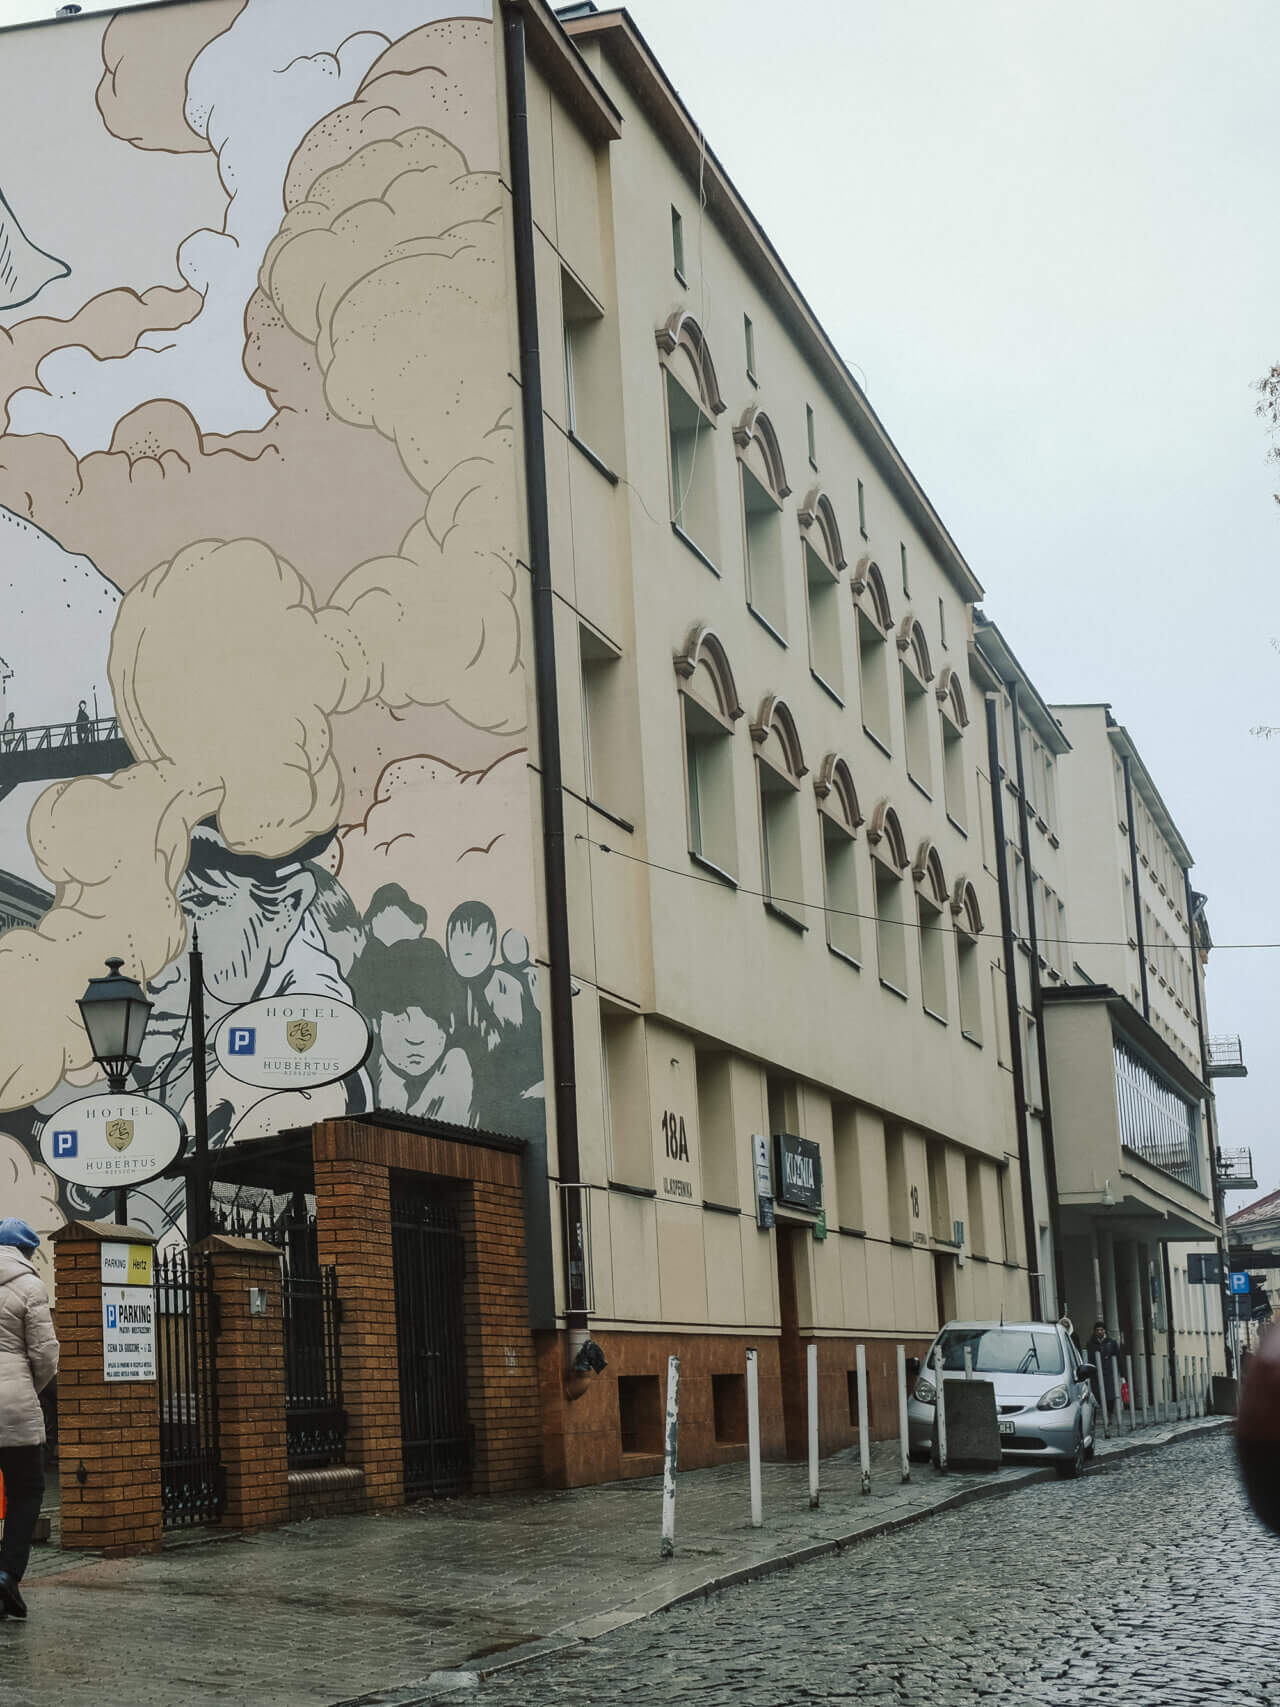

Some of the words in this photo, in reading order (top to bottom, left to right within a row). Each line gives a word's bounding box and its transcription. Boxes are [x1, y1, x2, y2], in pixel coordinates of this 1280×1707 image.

[266, 1007, 340, 1018] HOTEL
[234, 1031, 250, 1051] P
[263, 1060, 340, 1071] HUBERTUS
[86, 1106, 153, 1119] HOTEL
[661, 1109, 690, 1163] 18A
[58, 1134, 72, 1154] P
[86, 1158, 157, 1170] HUBERTUS
[910, 1184, 920, 1218] 18
[104, 1258, 127, 1269] PARKING
[132, 1258, 147, 1270] Hertz
[118, 1305, 151, 1323] PARKING
